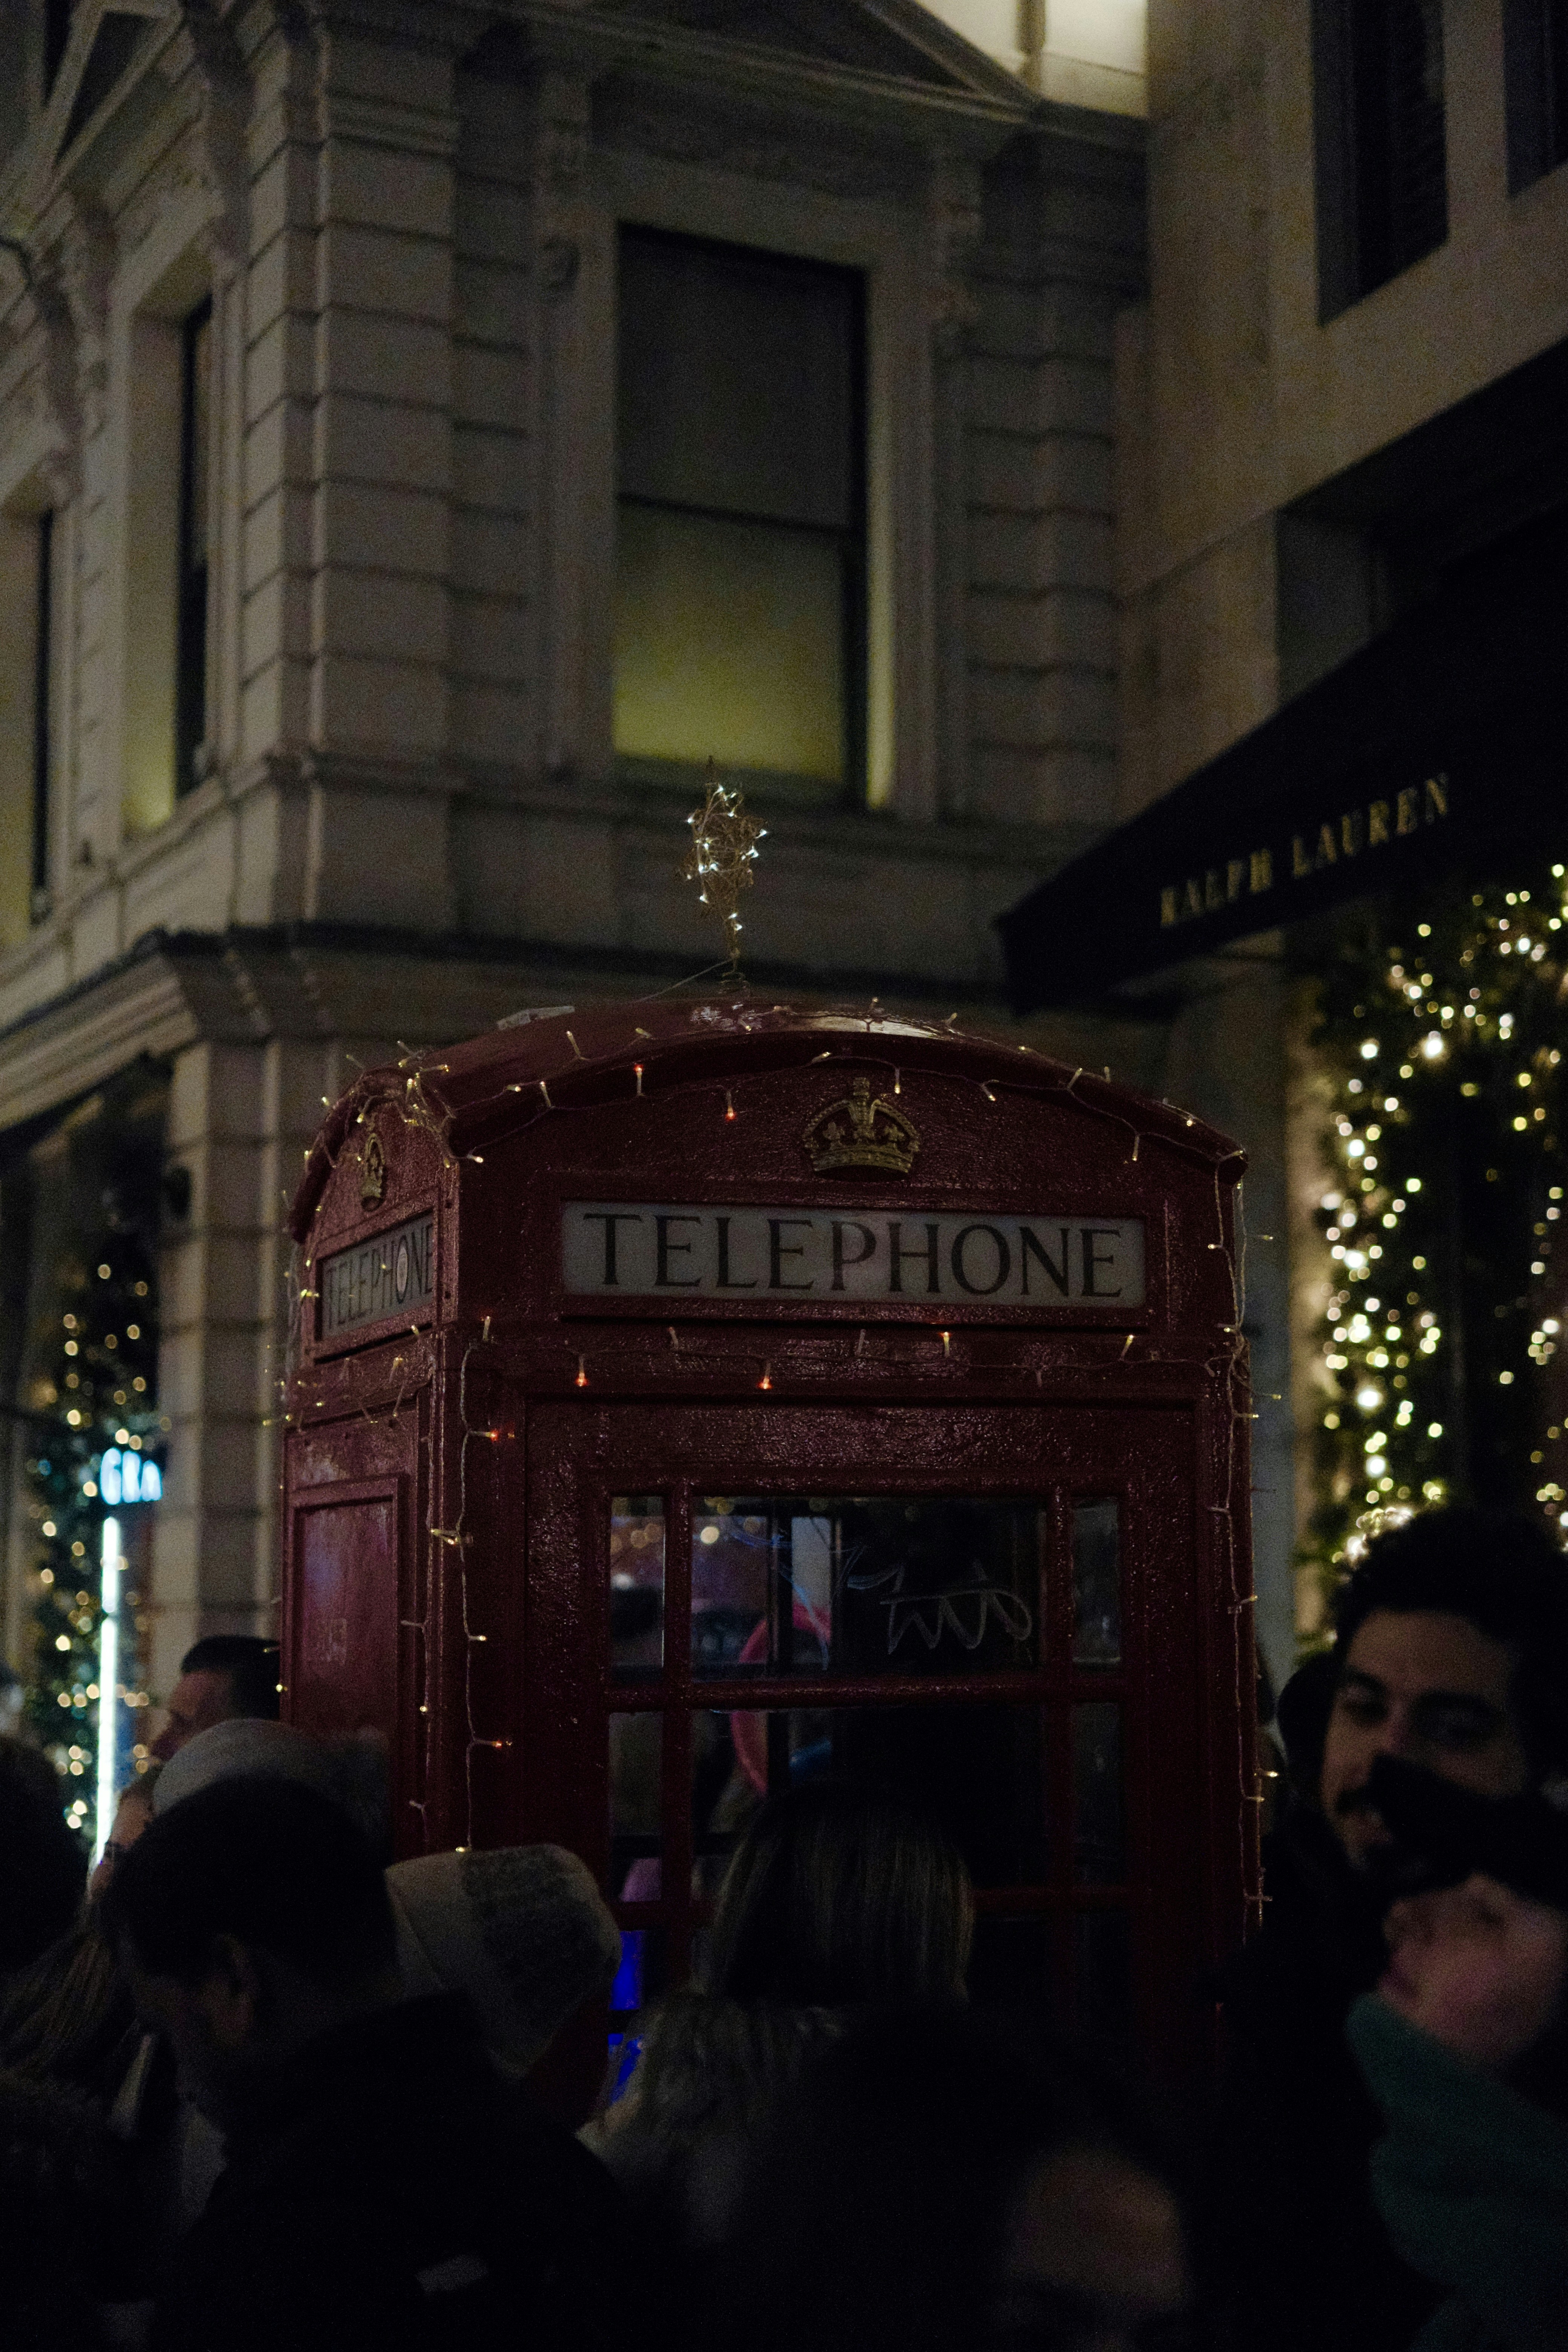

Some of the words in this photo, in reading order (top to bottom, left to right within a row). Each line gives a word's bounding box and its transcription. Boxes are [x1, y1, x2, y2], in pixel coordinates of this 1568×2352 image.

[1160, 848, 1273, 929] RALPH
[1291, 771, 1449, 880] LAUREN
[583, 1212, 1122, 1297] TELEPHONE
